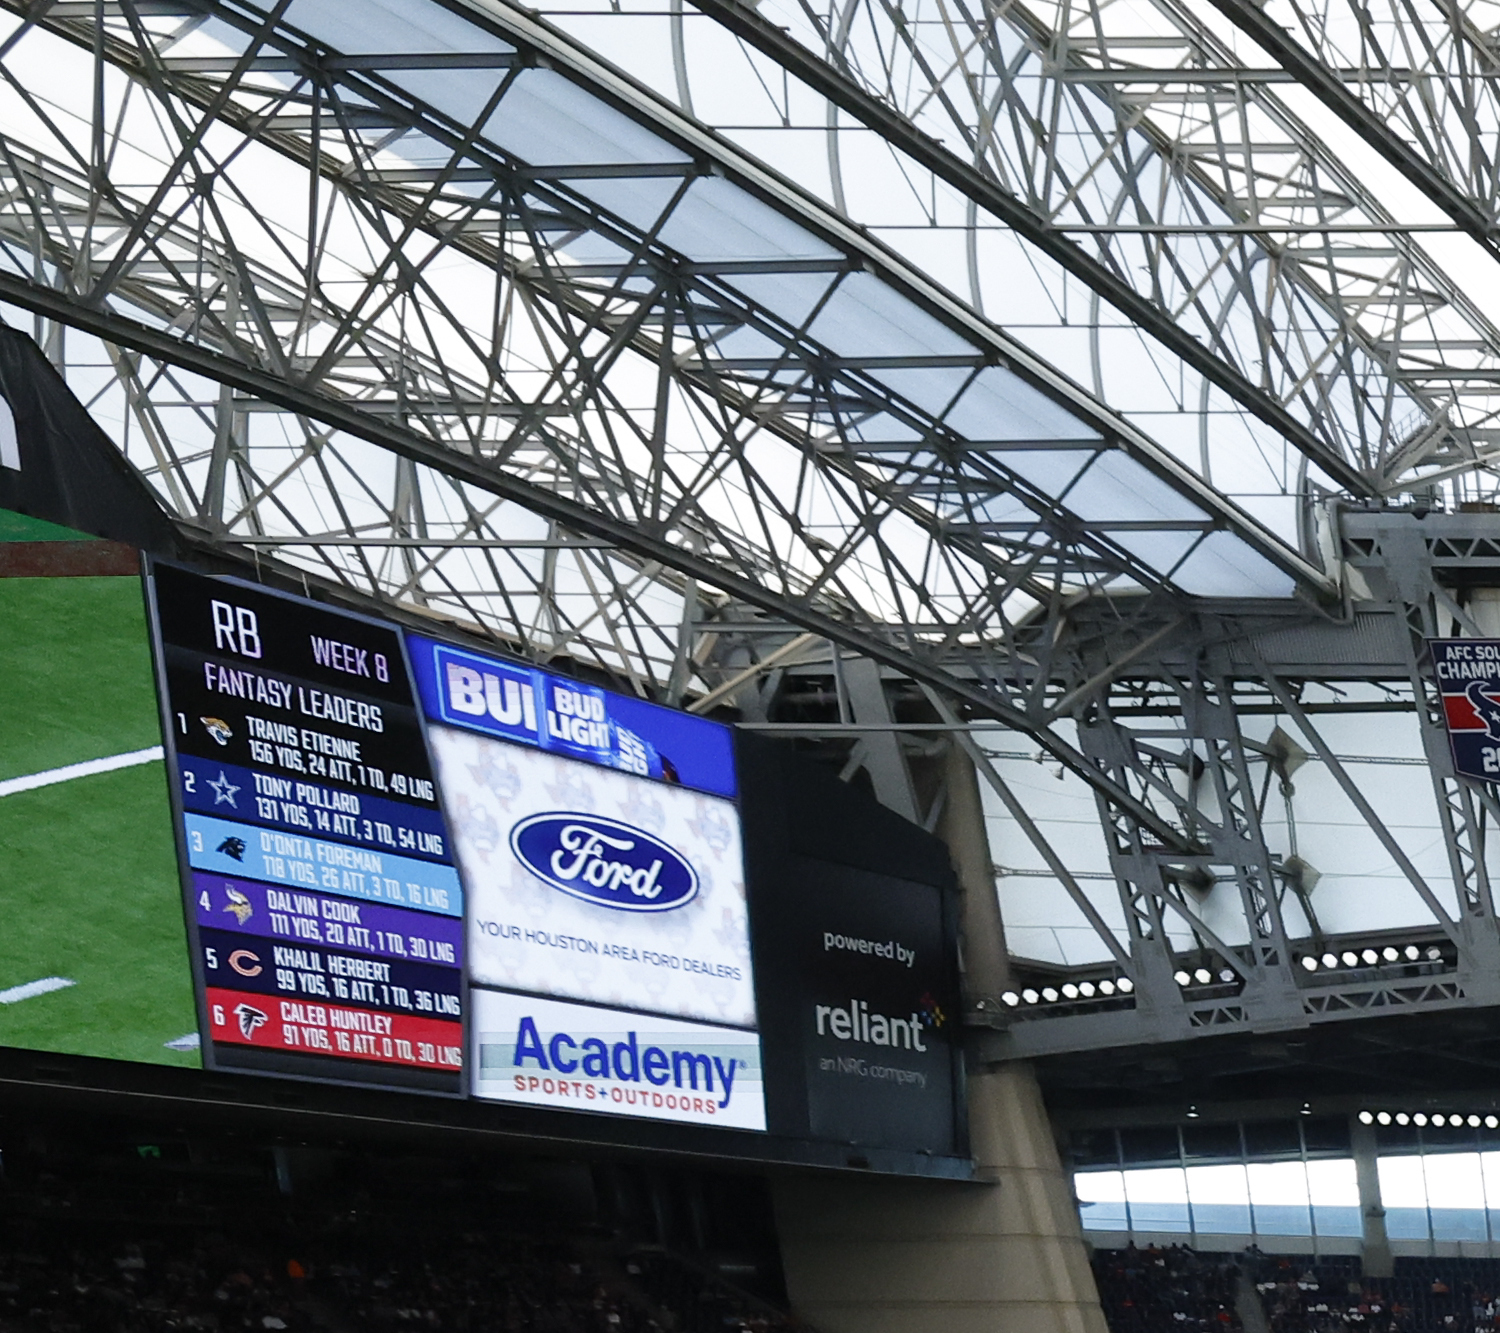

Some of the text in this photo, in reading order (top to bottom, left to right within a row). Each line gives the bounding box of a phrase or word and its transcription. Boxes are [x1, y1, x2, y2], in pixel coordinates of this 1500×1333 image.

[211, 600, 390, 684] RB WEEK 8
[1445, 645, 1473, 663] AFC
[204, 662, 384, 733] FANTASY LEADERS
[553, 685, 606, 722] BUD
[177, 712, 188, 735] 1
[245, 715, 362, 763] TRAVIS ETIENNE
[184, 771, 196, 794] 2
[252, 772, 361, 816] TONY POLLARD
[190, 831, 204, 852] 3
[317, 843, 383, 875] FOREMAN
[550, 824, 664, 899] Ford
[199, 890, 212, 912] 4
[267, 889, 362, 925] DALVIN COOK
[205, 947, 218, 970] 5
[273, 945, 391, 984] KHALIL HERBERT
[477, 918, 743, 982] YOUR HOUSTON AREA FORD DEALERS
[823, 930, 916, 969] powered by
[212, 1004, 226, 1026] 6
[280, 1001, 393, 1036] CALEB HUNTLEY
[814, 999, 927, 1054] reliant
[820, 1055, 929, 1090] an NRG company
